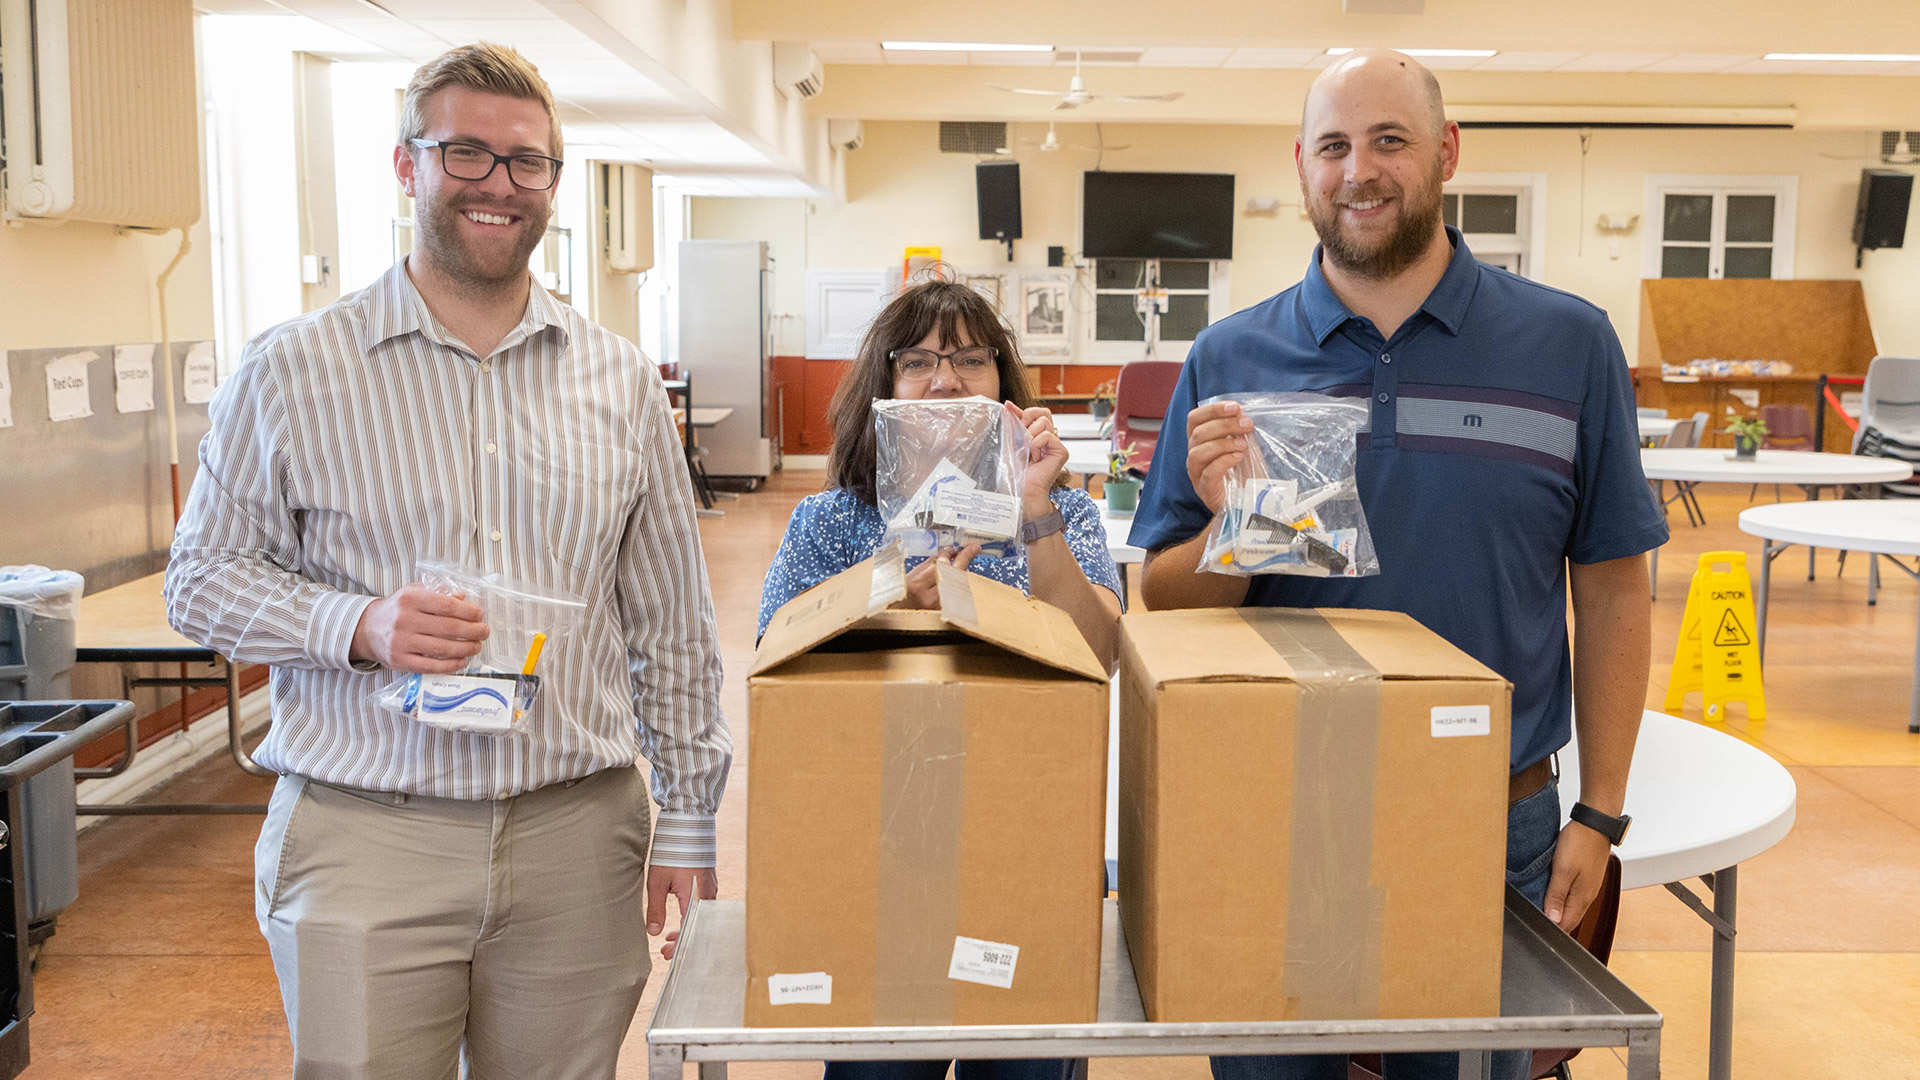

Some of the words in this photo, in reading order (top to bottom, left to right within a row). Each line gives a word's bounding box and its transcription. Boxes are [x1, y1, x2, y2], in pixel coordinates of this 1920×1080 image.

[137, 370, 150, 380] CUPS
[53, 377, 66, 390] Red
[68, 376, 84, 390] Cups
[1711, 591, 1745, 600] CAUTION
